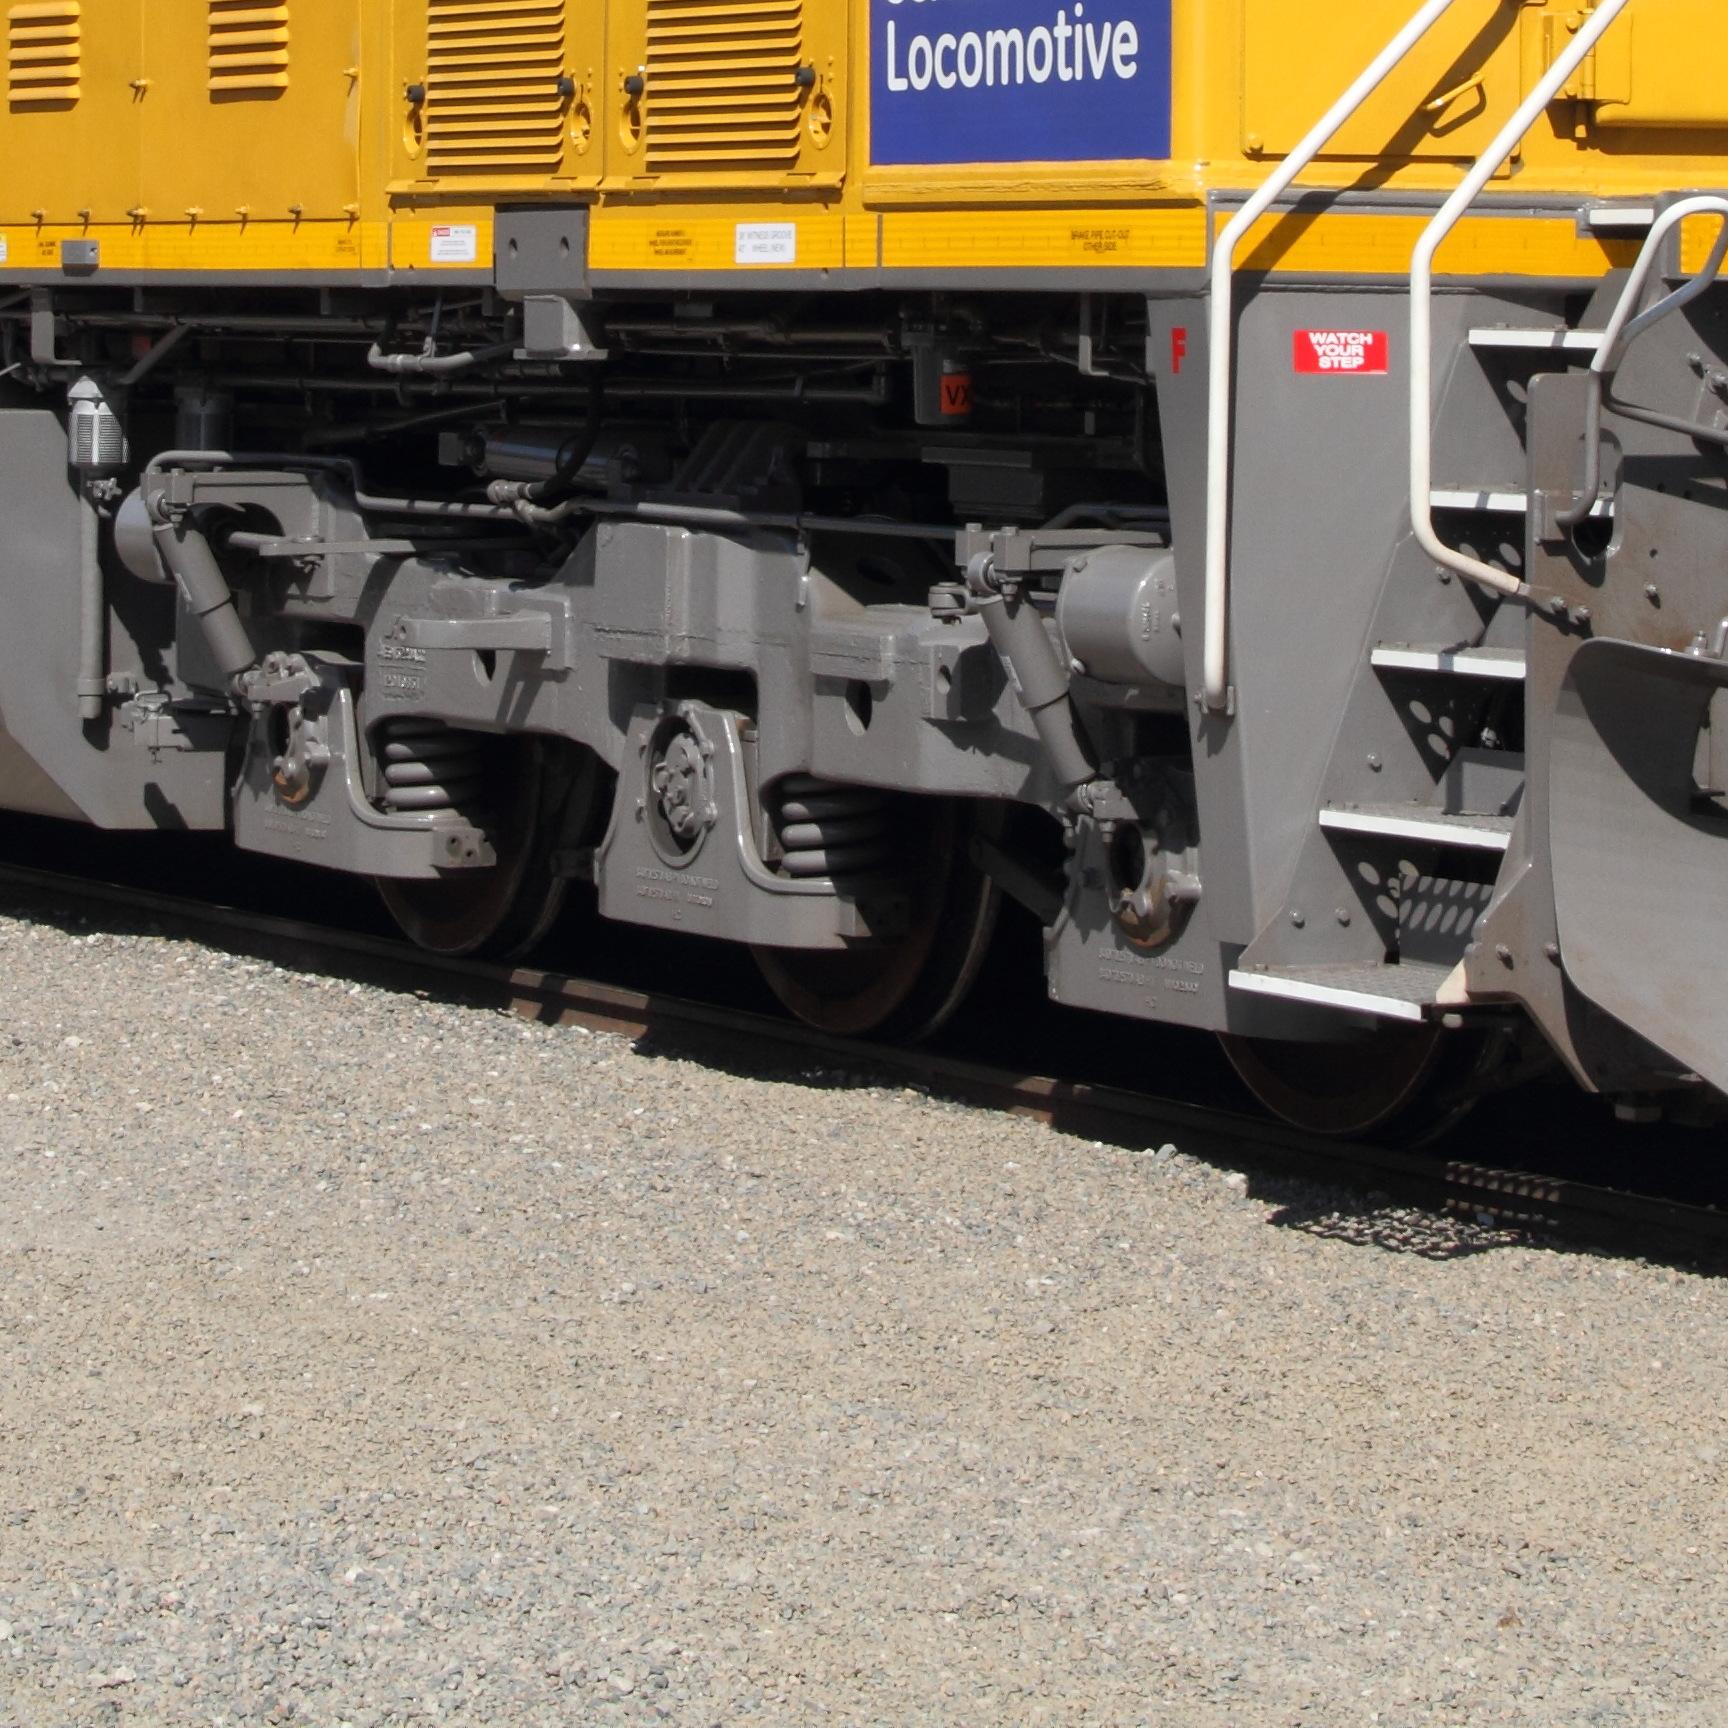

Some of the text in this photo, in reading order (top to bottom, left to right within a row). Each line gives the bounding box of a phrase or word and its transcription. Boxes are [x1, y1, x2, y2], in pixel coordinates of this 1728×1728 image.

[887, 2, 1139, 92] Locomotive
[1308, 332, 1373, 346] WATCH
[1171, 327, 1186, 374] F
[1314, 344, 1365, 357] YOUR
[1318, 356, 1365, 370] STEP
